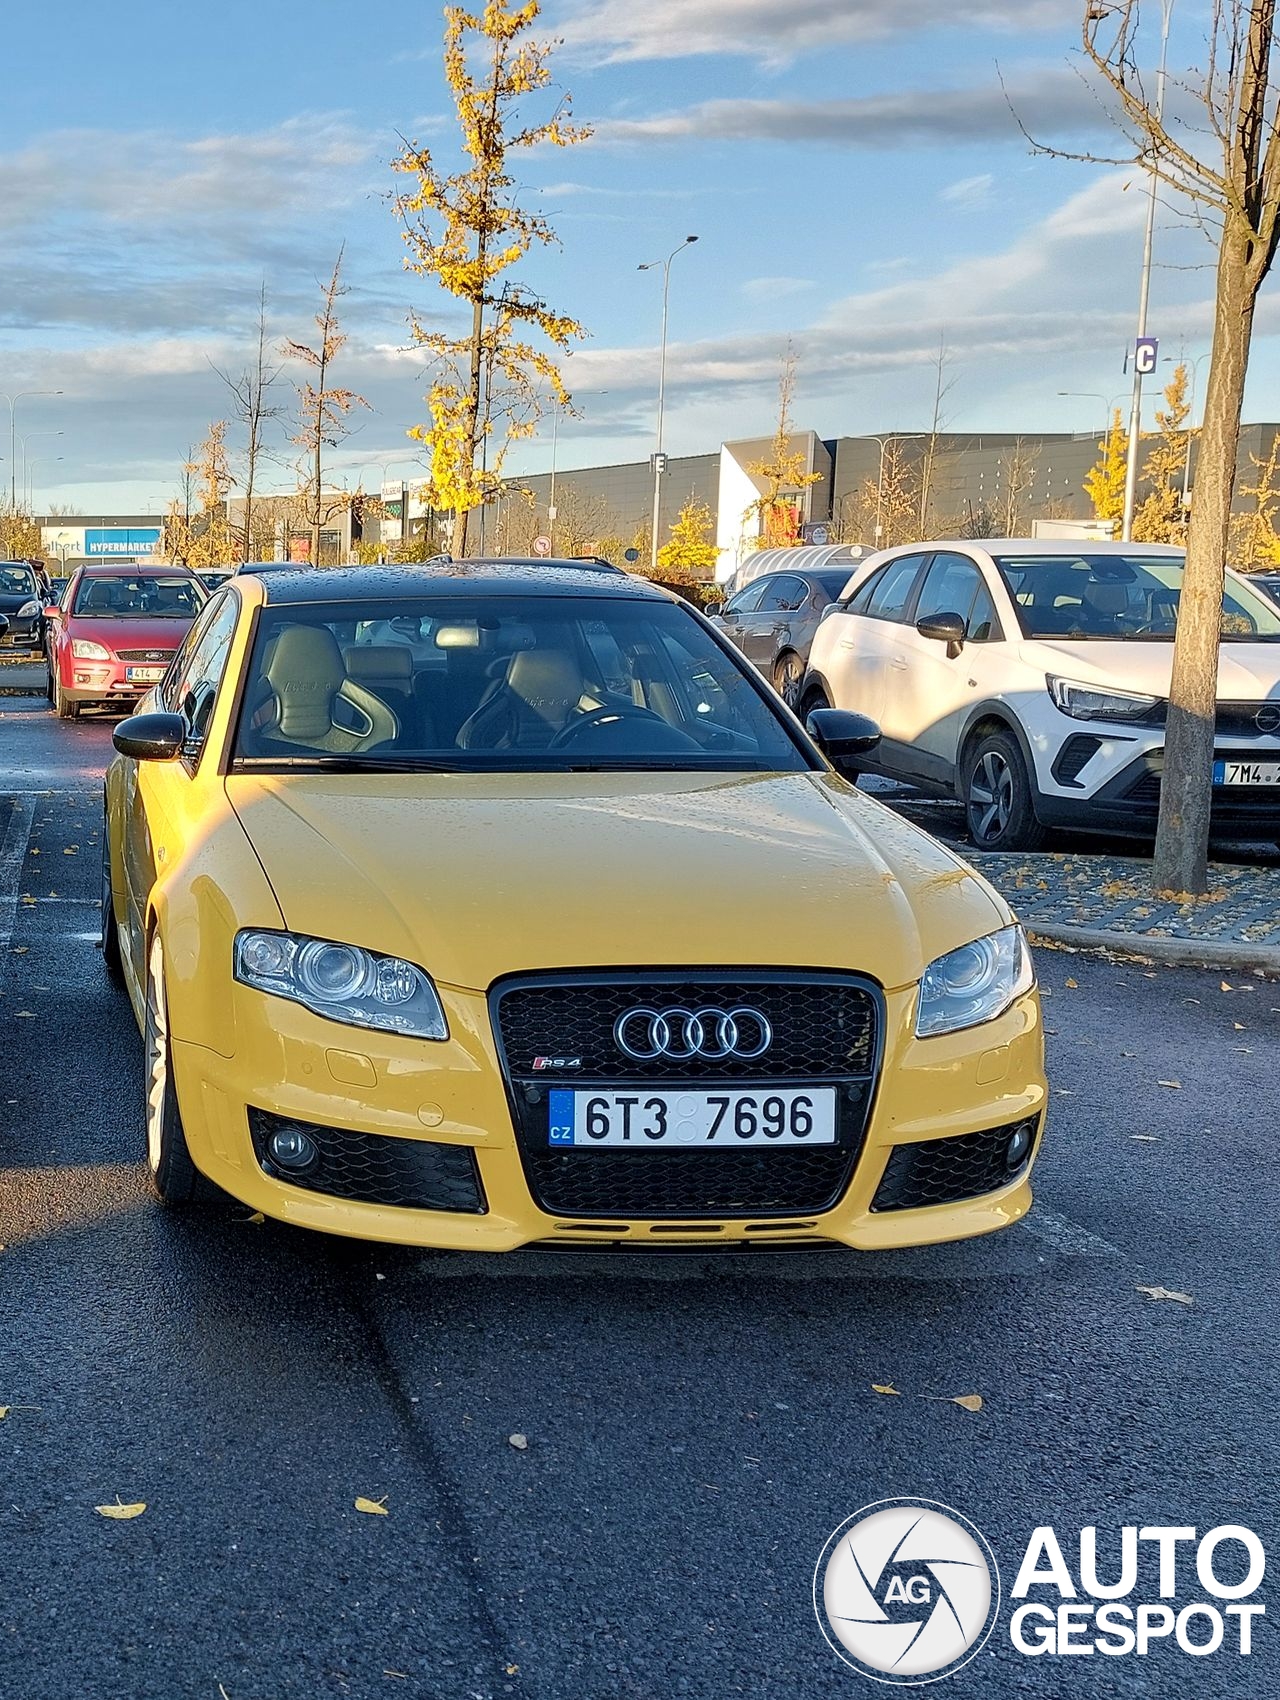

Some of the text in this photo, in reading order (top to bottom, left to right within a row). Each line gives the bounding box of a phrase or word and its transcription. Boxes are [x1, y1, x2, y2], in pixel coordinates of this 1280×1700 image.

[1136, 344, 1155, 372] C
[655, 456, 665, 472] E
[45, 541, 81, 552] albert
[89, 541, 157, 553] HYPERMARKET
[1228, 764, 1262, 783] 7M4
[550, 1095, 814, 1140] CZ 6T3 7696
